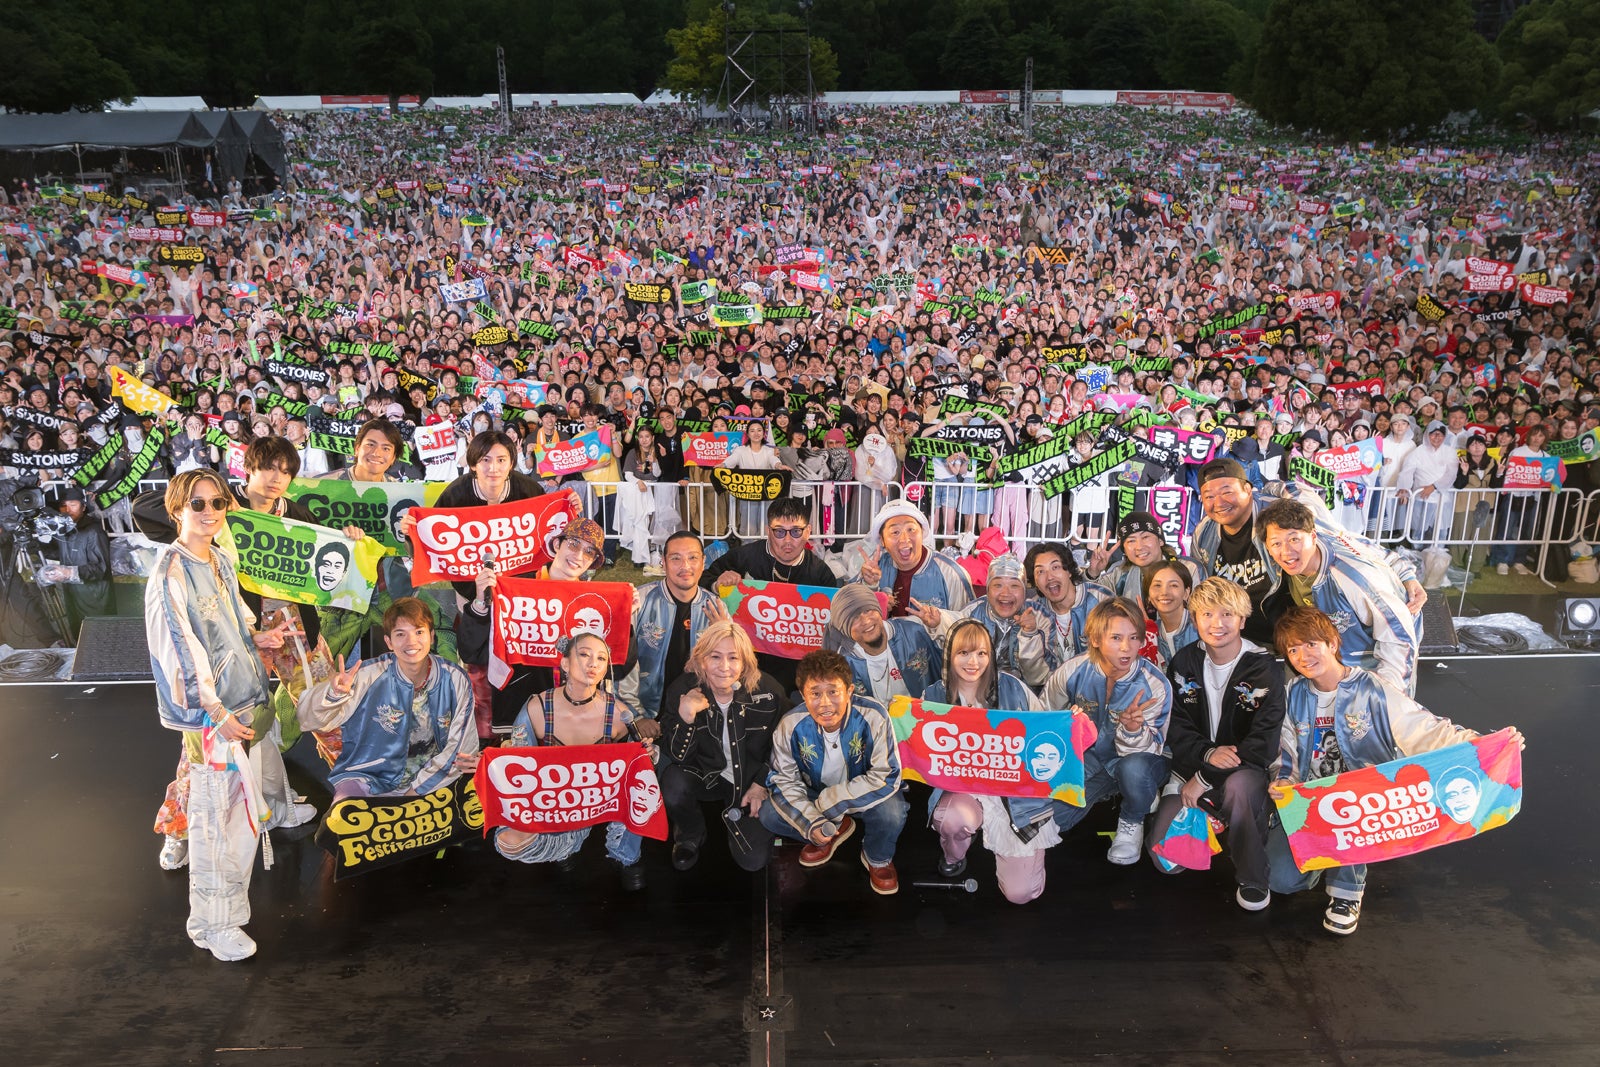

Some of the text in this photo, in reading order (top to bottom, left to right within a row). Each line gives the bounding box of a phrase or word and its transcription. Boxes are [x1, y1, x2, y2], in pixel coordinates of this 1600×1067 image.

[1468, 257, 1498, 268] GOBU
[625, 282, 660, 293] GOBU
[1468, 275, 1502, 284] GOBU
[1042, 347, 1077, 359] GOBU
[269, 363, 326, 382] SixTONES
[693, 438, 728, 451] GOBU
[937, 427, 1003, 440] SixTONES
[12, 452, 79, 465] SixTONES
[548, 445, 586, 462] GOBU
[562, 453, 587, 465] GOBU
[704, 448, 728, 456] GOBU
[1319, 451, 1361, 466] GOBU
[714, 468, 764, 485] GOBU
[727, 482, 763, 494] GOBU
[297, 494, 388, 520] GOBU
[226, 517, 315, 560] GOBU
[417, 512, 536, 551] GOBU
[246, 550, 311, 575] GOBU
[457, 536, 535, 564] GOBU
[238, 561, 307, 587] estival 2024
[426, 551, 534, 577] Festial 2024
[497, 594, 563, 623] OBU
[747, 595, 830, 624] GOBU
[753, 621, 823, 647] Festival 202
[528, 643, 558, 657] 2024
[922, 721, 1025, 754] GOBU
[928, 754, 1021, 782] Festival 2024
[953, 749, 1023, 770] GOBU
[487, 755, 626, 795] GOBU
[532, 783, 620, 810] GOBU
[1318, 781, 1433, 825] GOBU
[326, 787, 454, 835] GOBU
[498, 796, 619, 825] Festival 2024
[1360, 801, 1436, 833] GOBU
[371, 808, 453, 843] GOBU
[1331, 818, 1439, 851] Festival 2024
[338, 826, 453, 867] Festival 2024
